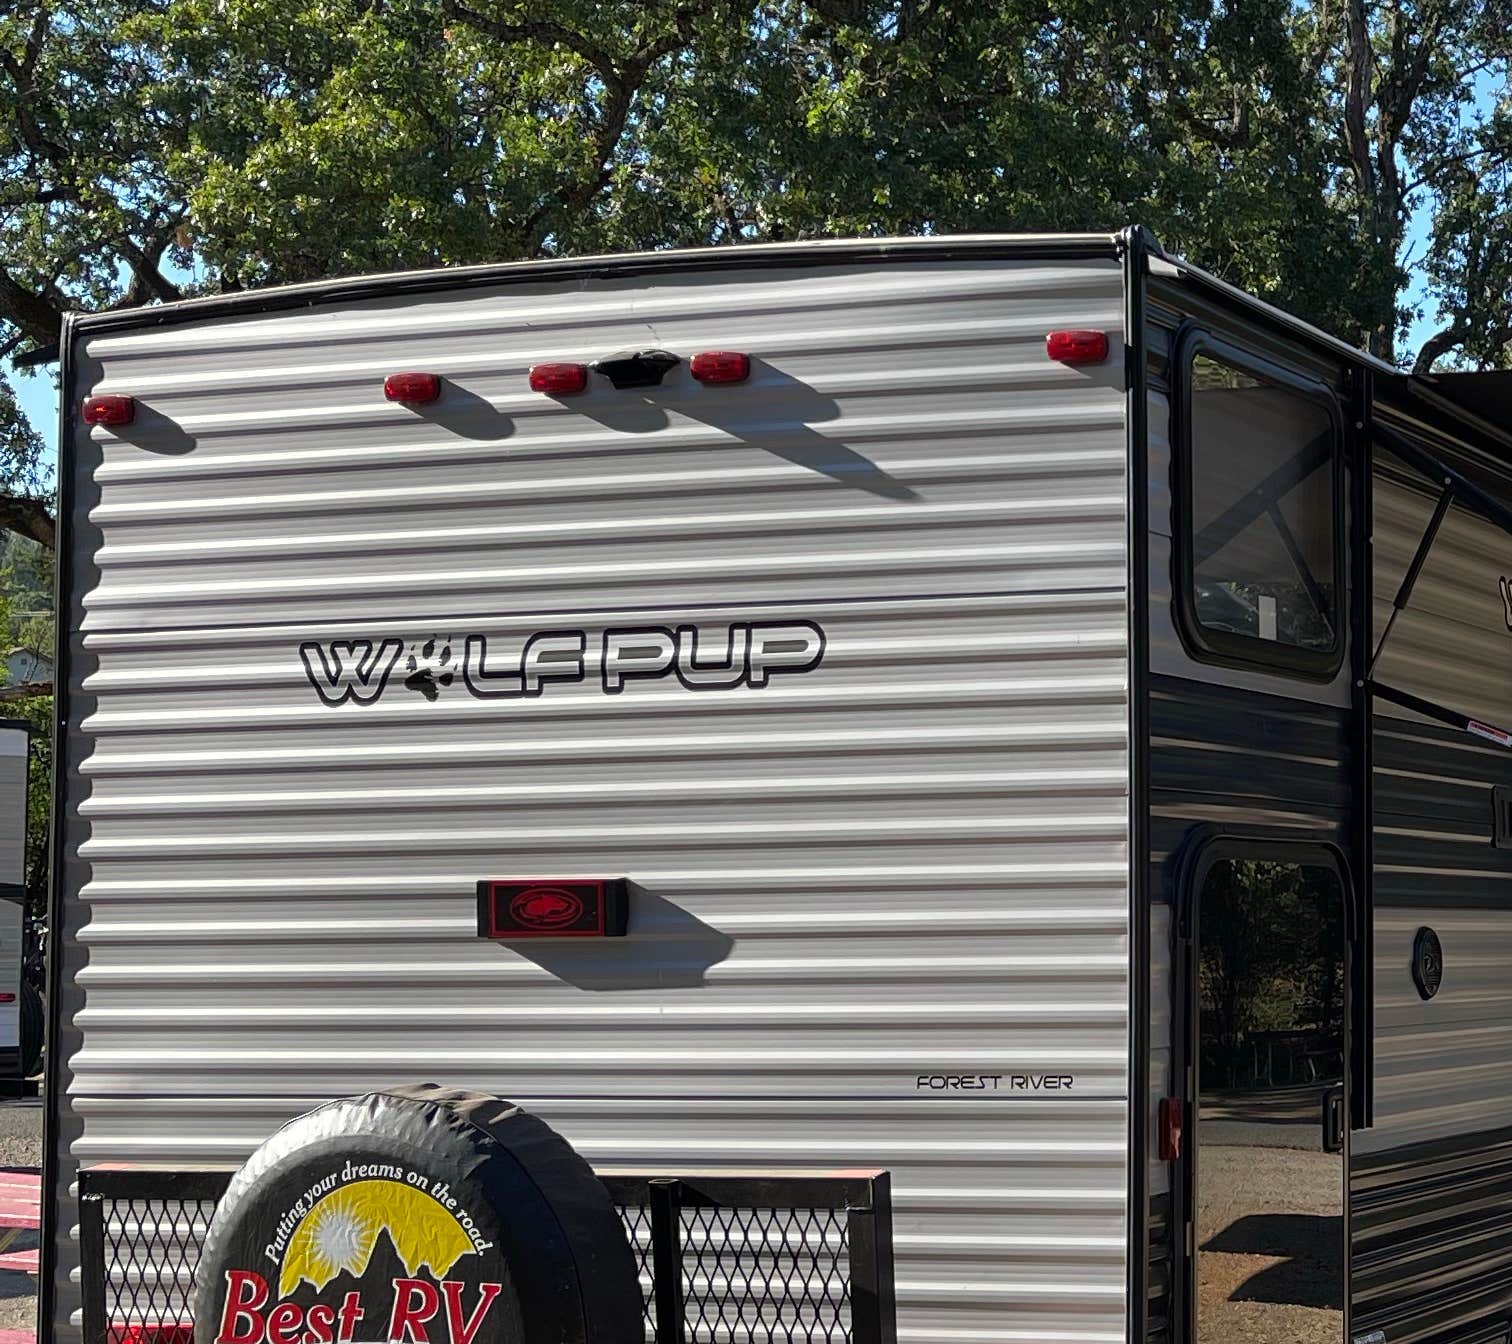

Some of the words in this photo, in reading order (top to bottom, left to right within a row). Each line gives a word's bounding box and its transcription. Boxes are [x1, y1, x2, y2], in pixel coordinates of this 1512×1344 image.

[916, 1075, 1002, 1090] FOREST
[1010, 1075, 1074, 1090] RIVER
[264, 1198, 308, 1266] Putting
[303, 1172, 338, 1209] your
[341, 1160, 404, 1182] dreams
[406, 1171, 429, 1190] on
[430, 1181, 458, 1211] the
[455, 1208, 494, 1257] road.
